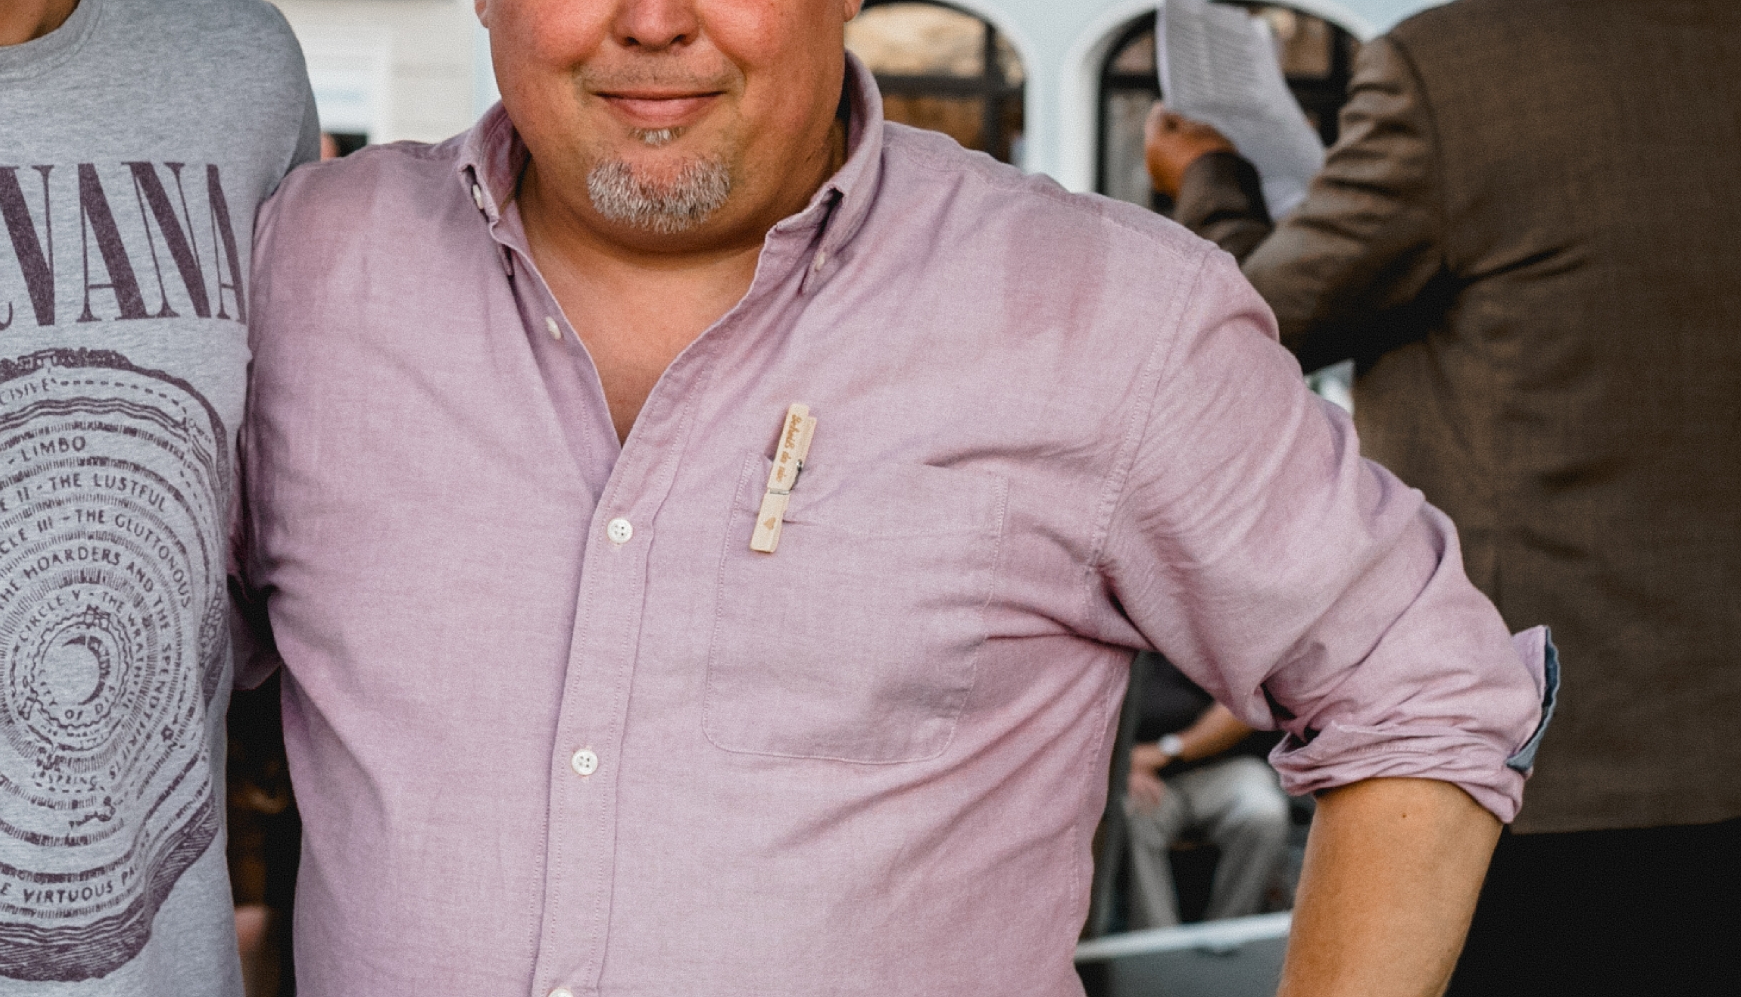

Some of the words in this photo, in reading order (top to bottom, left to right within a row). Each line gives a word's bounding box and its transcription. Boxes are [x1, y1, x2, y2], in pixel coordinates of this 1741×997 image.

[21, 436, 86, 463] LIMBO
[17, 486, 30, 503] II
[49, 472, 82, 491] THE
[93, 473, 166, 513] LUSTFUL
[37, 515, 54, 533] III
[75, 508, 106, 524] THE
[114, 513, 191, 609] GLUTTONOUS
[23, 546, 120, 580] HOARDERS
[126, 561, 154, 593] AND
[153, 595, 171, 631] THE
[18, 596, 65, 643] CIRCLE
[102, 591, 125, 614] THE
[23, 880, 114, 903] VIRTUOUS
